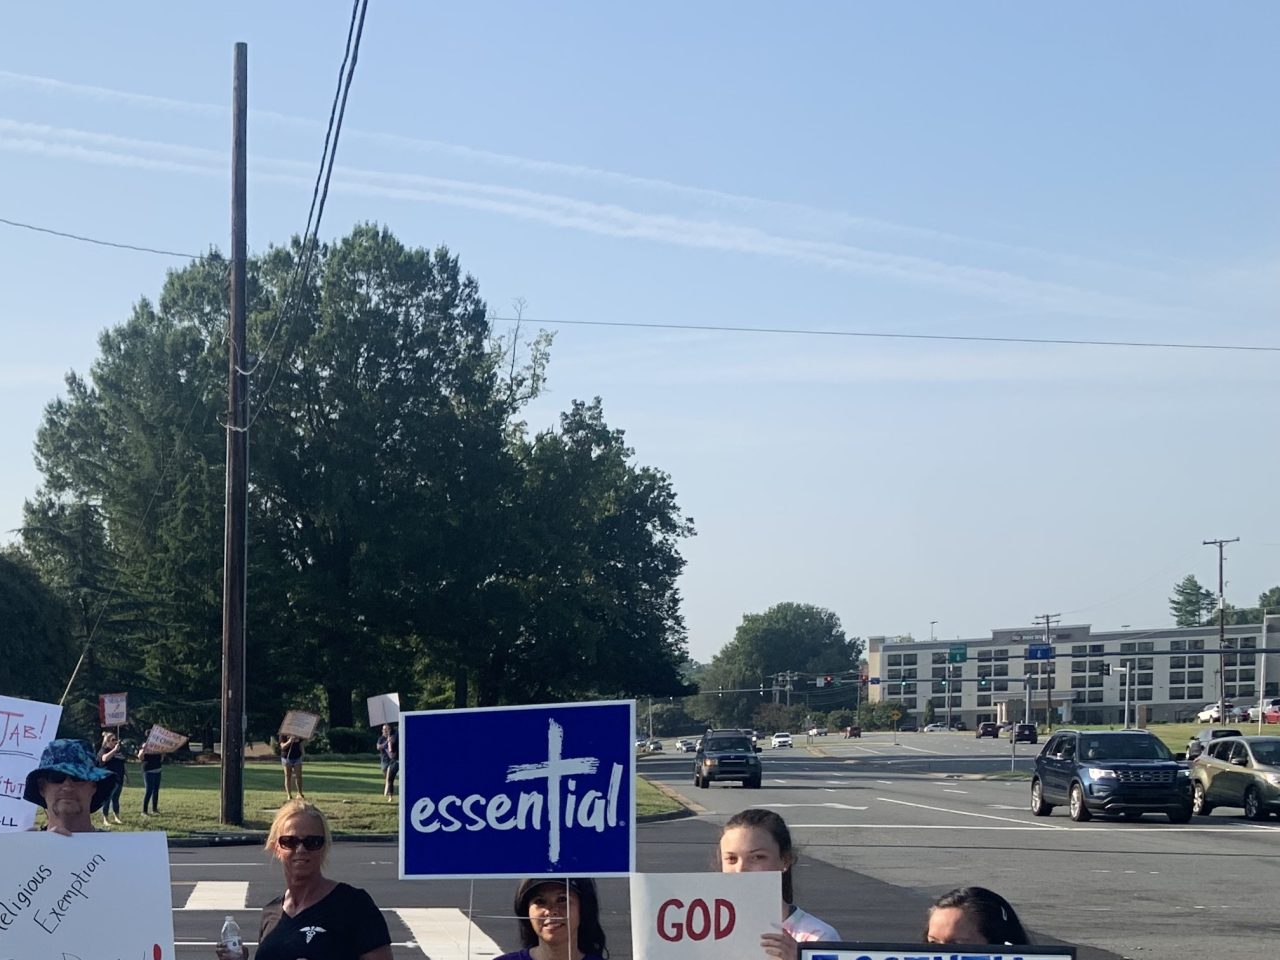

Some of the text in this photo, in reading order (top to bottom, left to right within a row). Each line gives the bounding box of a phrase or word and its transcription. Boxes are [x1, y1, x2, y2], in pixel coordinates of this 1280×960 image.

[411, 717, 624, 863] essential
[33, 853, 106, 934] Exemption
[657, 898, 736, 942] GOD
